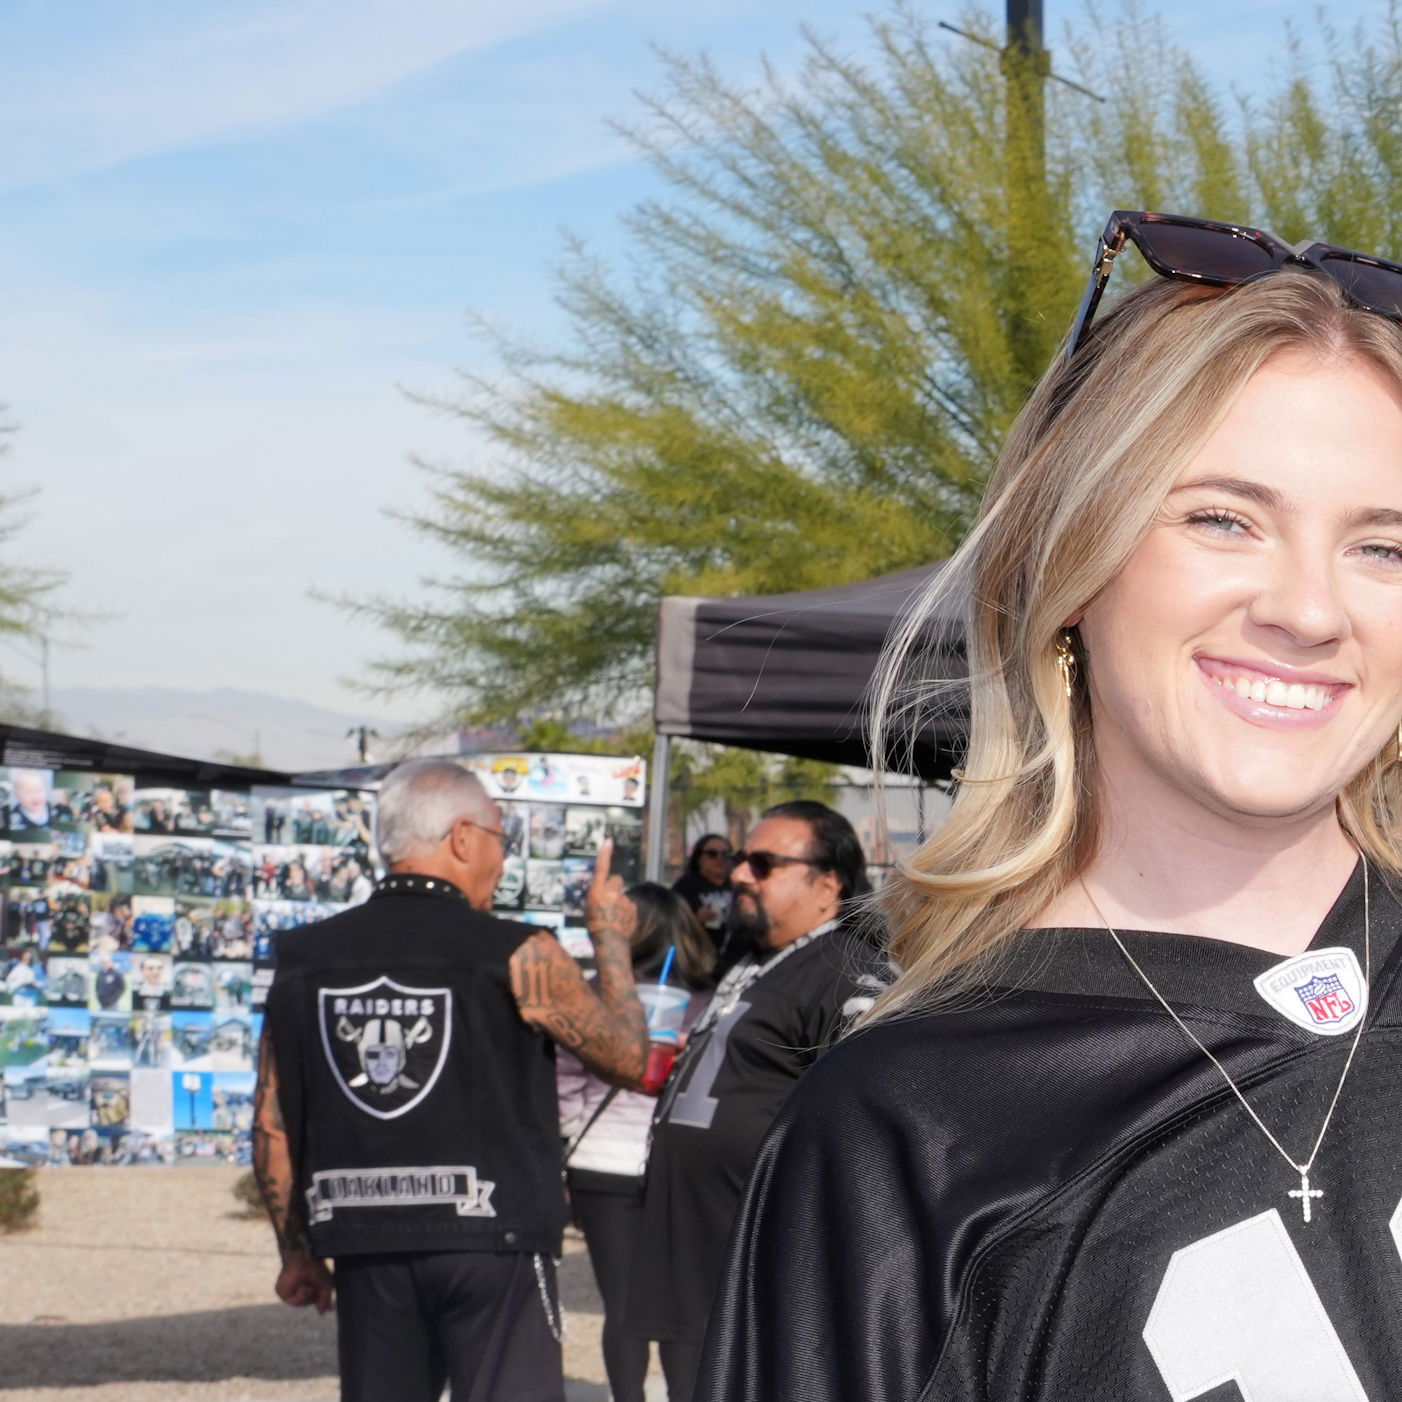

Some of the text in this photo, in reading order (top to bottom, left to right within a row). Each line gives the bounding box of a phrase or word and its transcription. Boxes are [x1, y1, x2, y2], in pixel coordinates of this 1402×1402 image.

[1268, 957, 1348, 993] EQUIPMENT
[333, 997, 436, 1016] RAIDERS
[1307, 991, 1352, 1021] NFL
[328, 1173, 456, 1201] OAKLAND
